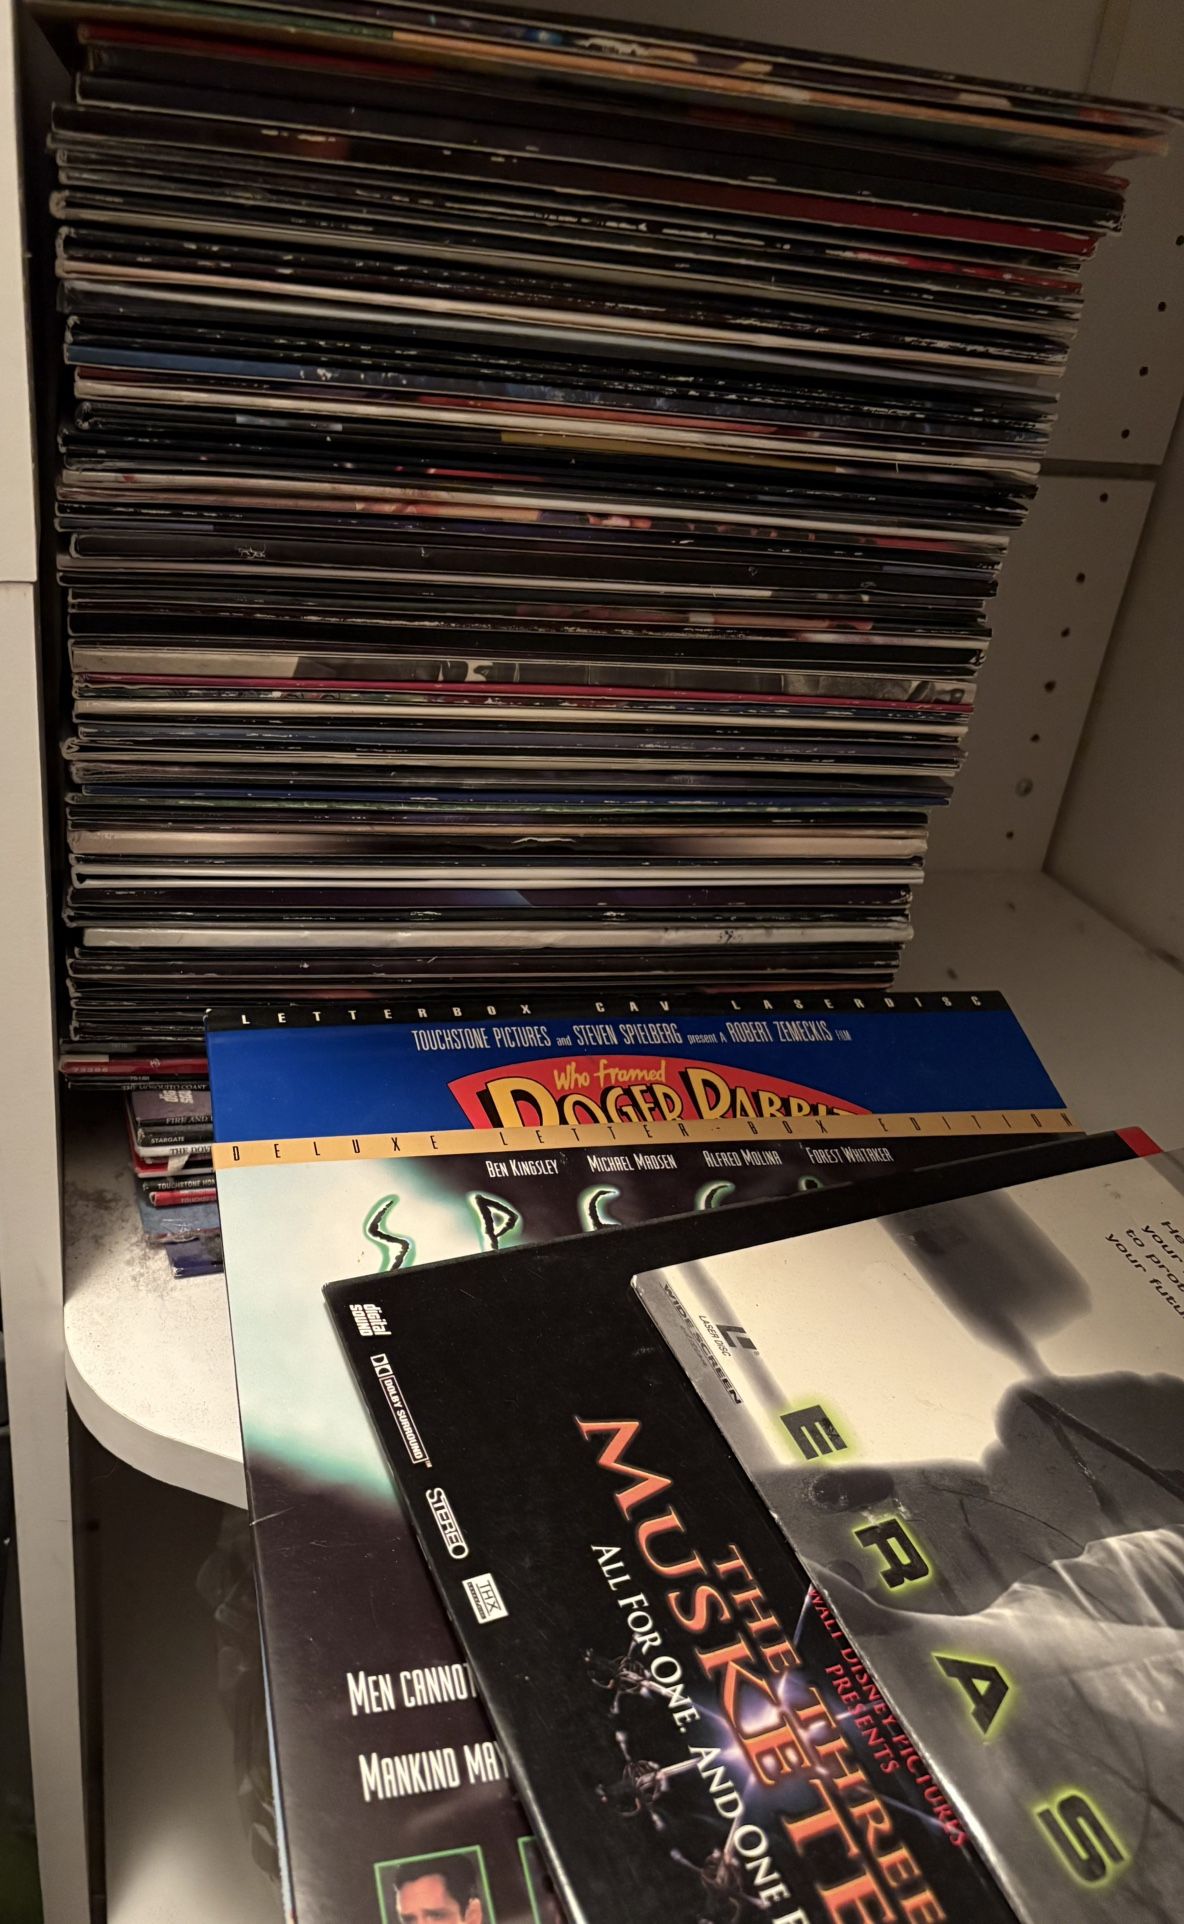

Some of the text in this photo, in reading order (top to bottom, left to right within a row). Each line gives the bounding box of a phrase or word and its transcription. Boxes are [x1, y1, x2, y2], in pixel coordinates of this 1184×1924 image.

[241, 996, 982, 1024] LETTERBOX CAV LASERDISC
[411, 1027, 491, 1051] TOUCHSTONE
[492, 1025, 552, 1049] PICTURES
[556, 1034, 573, 1048] and
[572, 1024, 619, 1047] STEVEN
[619, 1022, 684, 1045] SPIELBERG
[687, 1031, 719, 1045] present
[719, 1031, 727, 1043] A
[725, 1021, 773, 1043] ROBERT
[772, 1020, 833, 1042] ZEMECKIS
[553, 1058, 667, 1091] Who framed
[151, 1136, 185, 1144] STARGATE
[232, 1134, 439, 1162] DELUXE
[878, 1113, 1073, 1131] EDITION
[805, 1145, 894, 1165] FOREST WHITAKER
[485, 1158, 559, 1178] BEN KINGSLEY
[586, 1152, 678, 1173] MICHAEL MADSEN
[702, 1148, 783, 1168] ALFRED MOLINA
[1105, 1233, 1147, 1272] your
[1125, 1228, 1145, 1247] to
[1141, 1225, 1183, 1263] your
[663, 1283, 695, 1330] WIDE
[692, 1332, 742, 1405] SCREEN
[699, 1314, 732, 1357] LASER DISC
[384, 1378, 403, 1409] DOLBY
[396, 1409, 423, 1460] SURROUND
[425, 1487, 469, 1560] STEREO
[477, 1579, 502, 1614] THX
[346, 1670, 396, 1717] MEN
[590, 1544, 632, 1591] ALL
[617, 1592, 662, 1655] FOR
[687, 1744, 745, 1819] AND
[733, 1824, 792, 1907] ONE
[713, 1543, 947, 1924] THE THREE
[807, 1588, 968, 1848] WALT DISNEY PICTURES
[824, 1663, 901, 1776] PRESENTS
[358, 1747, 462, 1803] MANKIND
